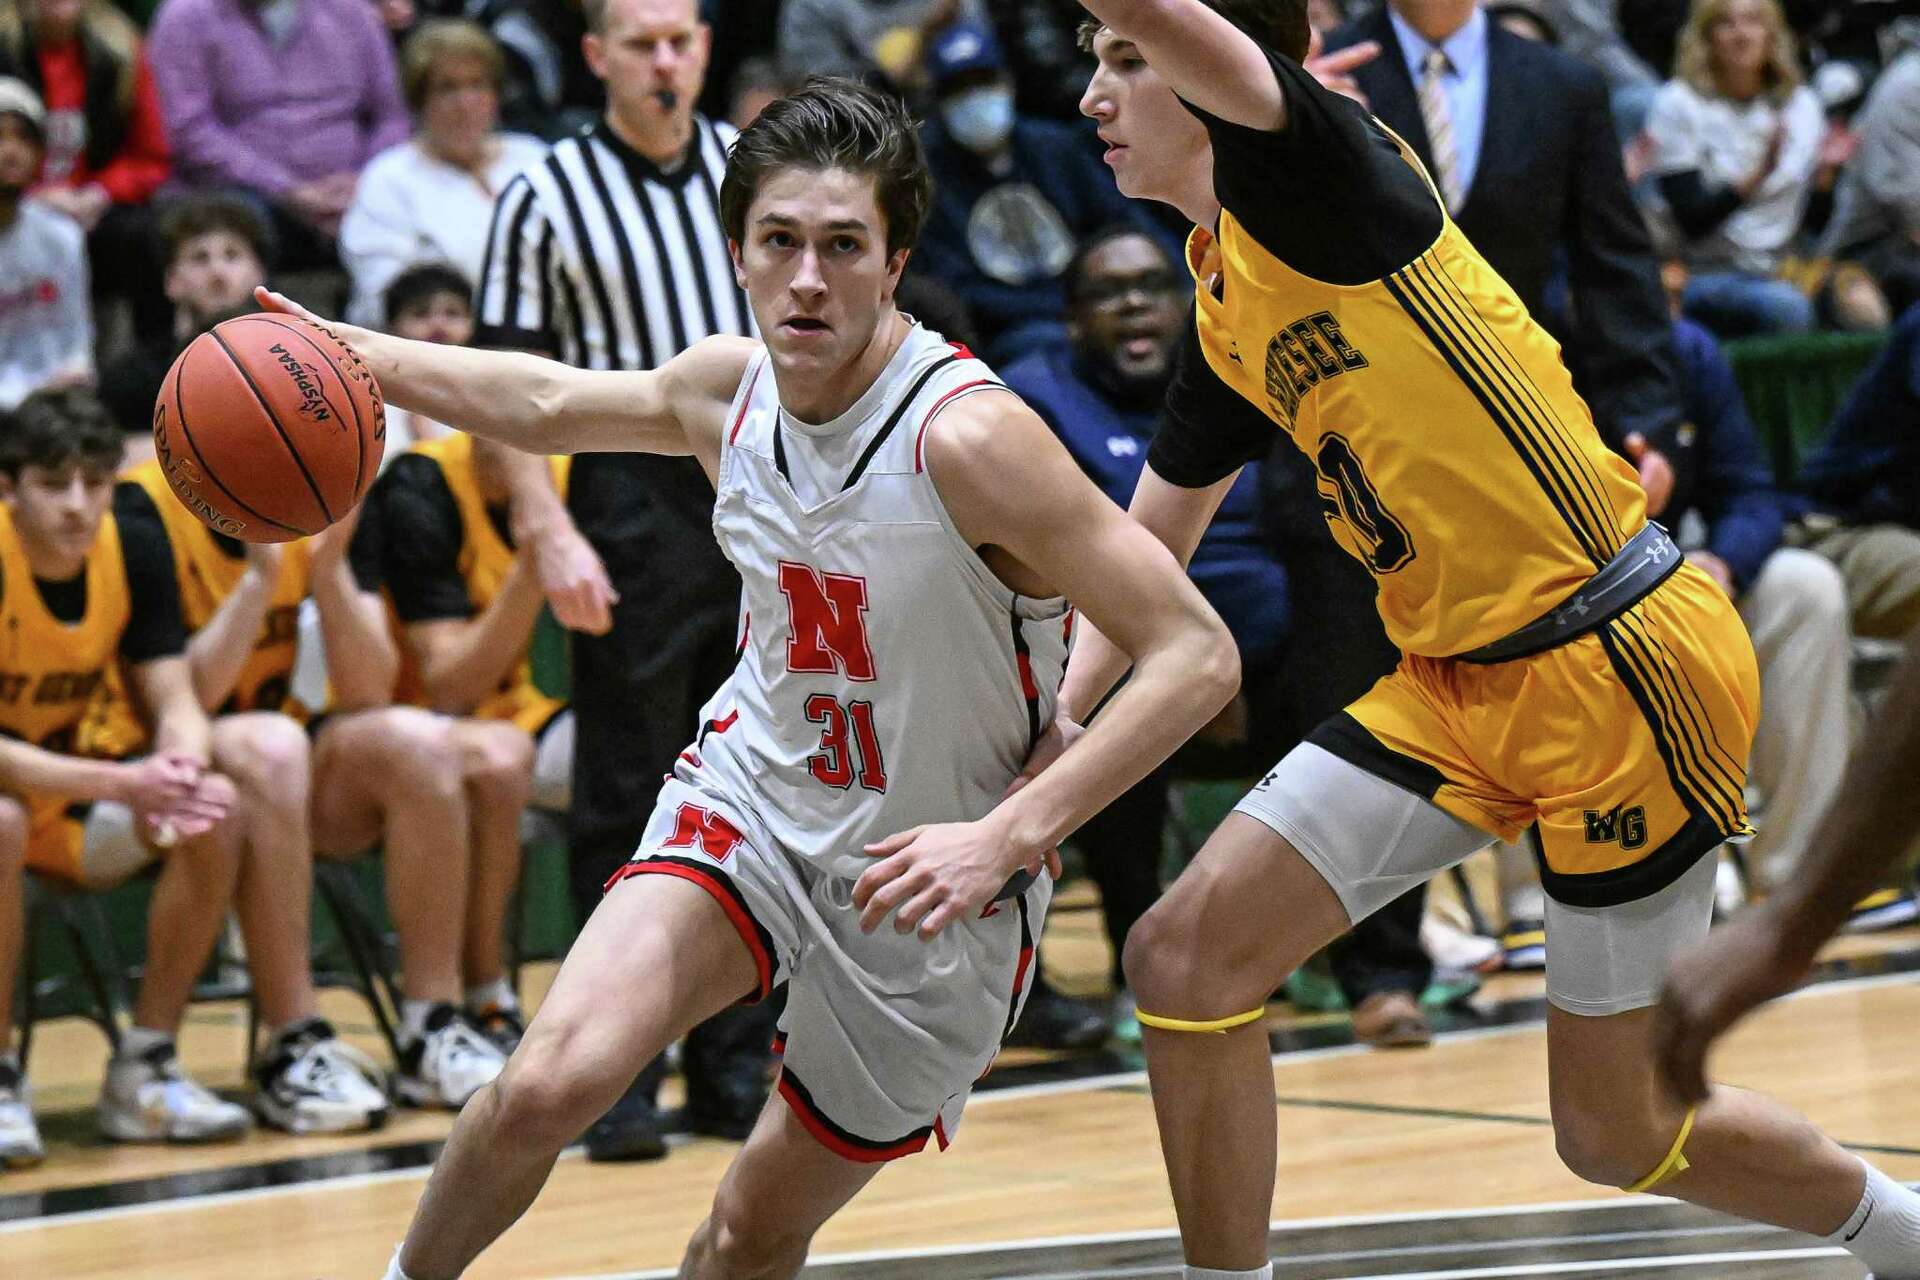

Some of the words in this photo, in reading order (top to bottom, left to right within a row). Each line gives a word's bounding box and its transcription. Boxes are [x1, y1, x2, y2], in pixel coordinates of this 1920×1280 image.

[778, 560, 876, 682] N
[804, 693, 887, 794] 31
[658, 801, 744, 864] N
[1584, 804, 1649, 851] WG
